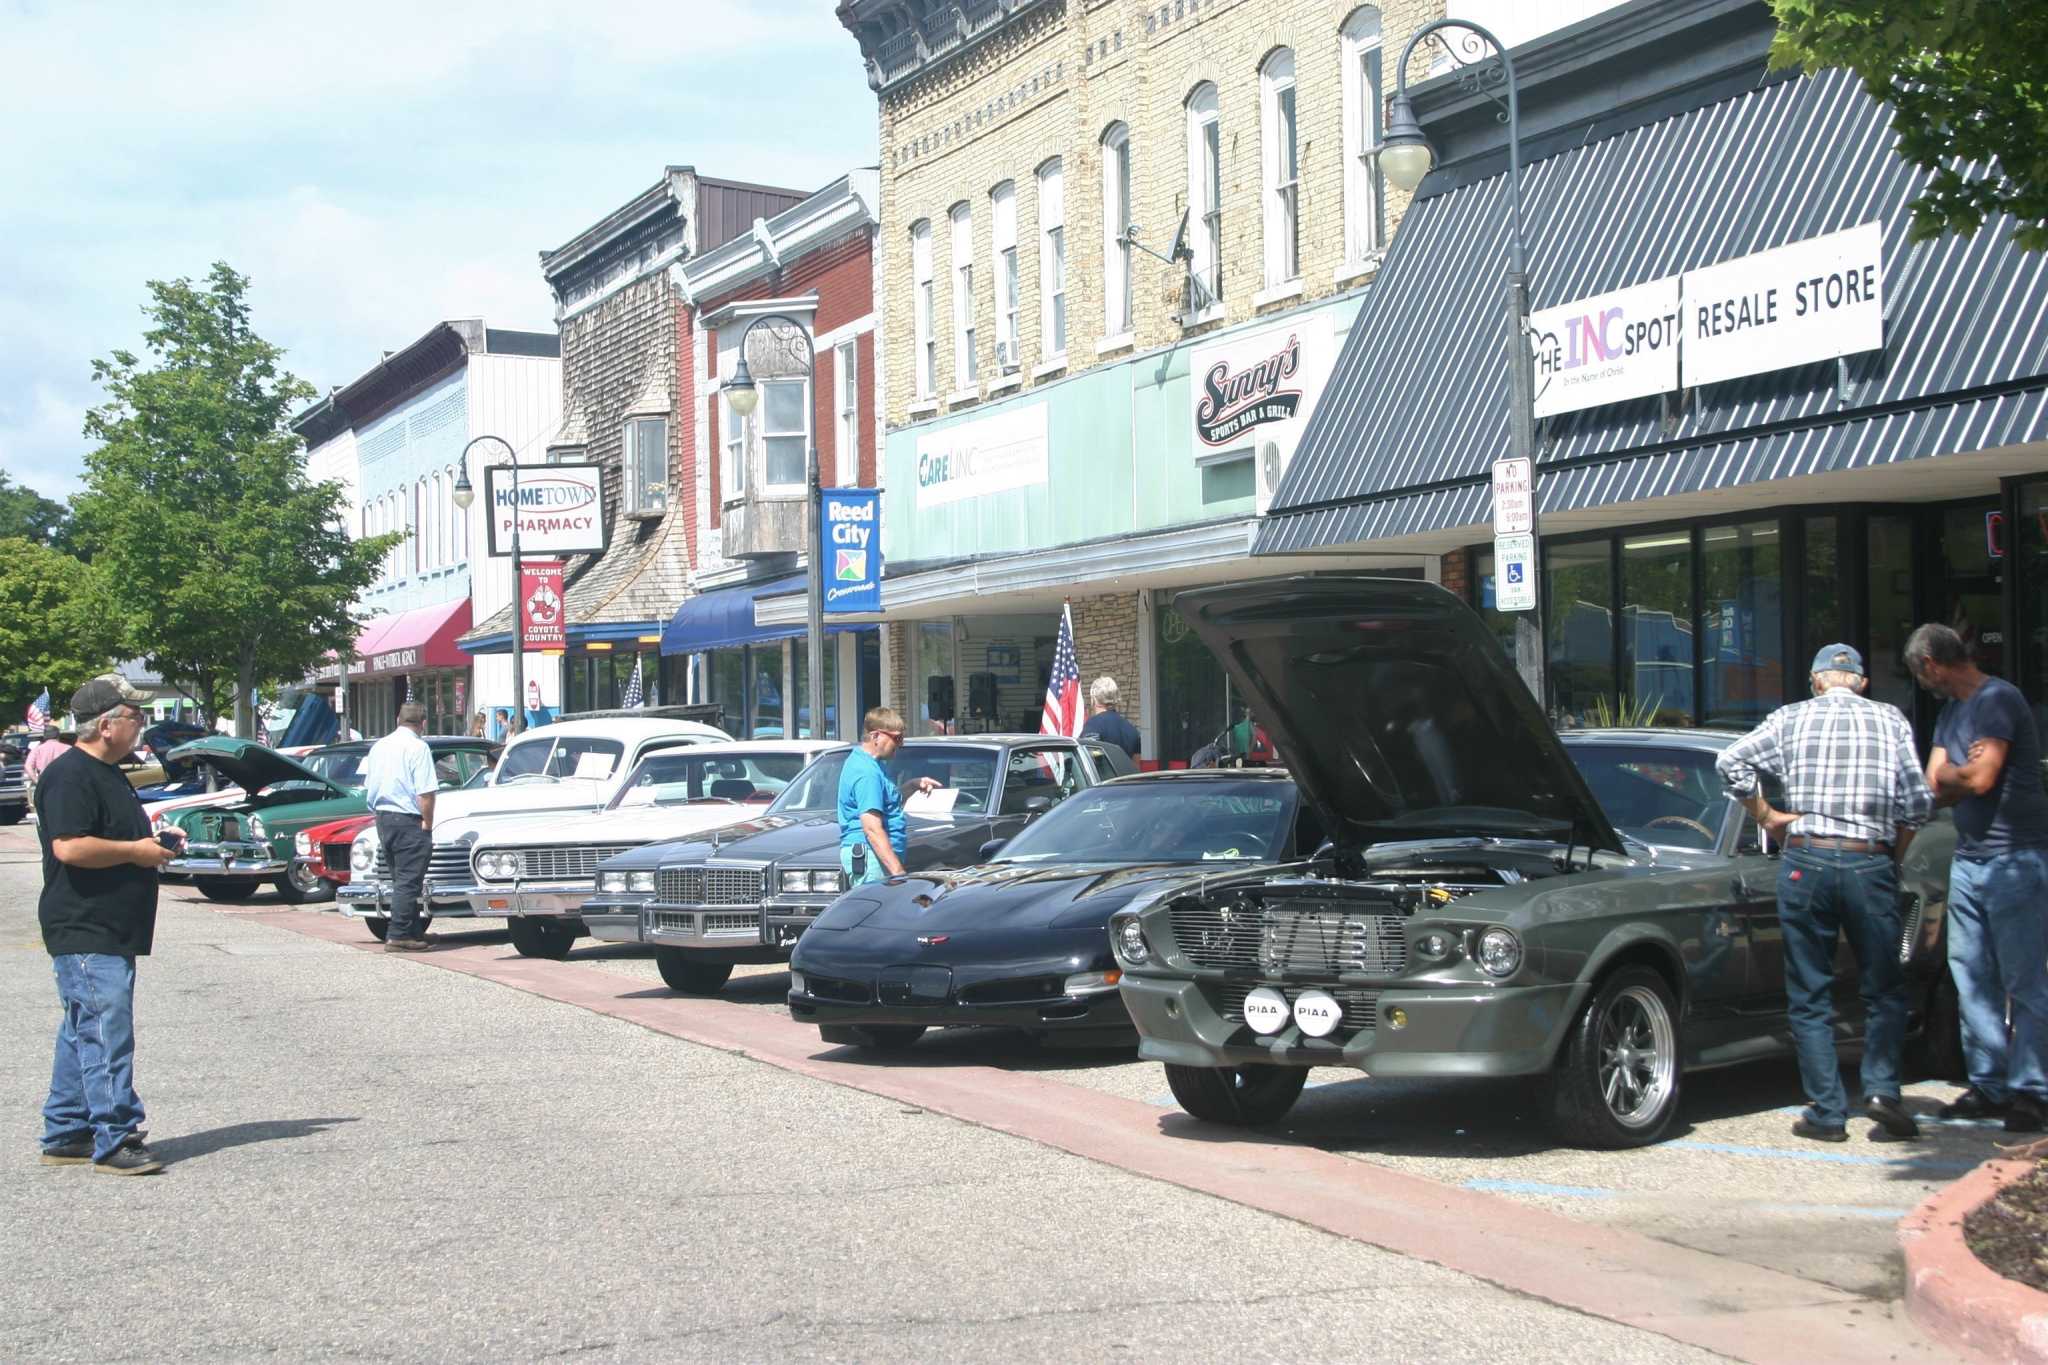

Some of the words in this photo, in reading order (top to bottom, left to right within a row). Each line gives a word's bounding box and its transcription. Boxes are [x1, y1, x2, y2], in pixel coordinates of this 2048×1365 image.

[1564, 306, 1625, 370] INC
[1625, 314, 1676, 356] SPOT
[1698, 289, 1778, 339] RESALE
[1795, 265, 1876, 317] STORE
[1210, 418, 1240, 441] SPORTS
[1240, 408, 1258, 427] BAR
[1266, 405, 1291, 419] GRILL
[1505, 465, 1518, 478] NO
[1496, 480, 1528, 495] PARKING
[496, 486, 596, 507] HOMETOWN
[829, 501, 873, 521] Reed
[504, 517, 593, 534] PHARMACY
[832, 523, 870, 548] City
[1501, 552, 1527, 561] PARKING
[523, 568, 562, 576] WELCOME
[538, 576, 549, 584] TO
[1248, 1005, 1278, 1014] PIAA
[1298, 1007, 1329, 1017] PIAA
